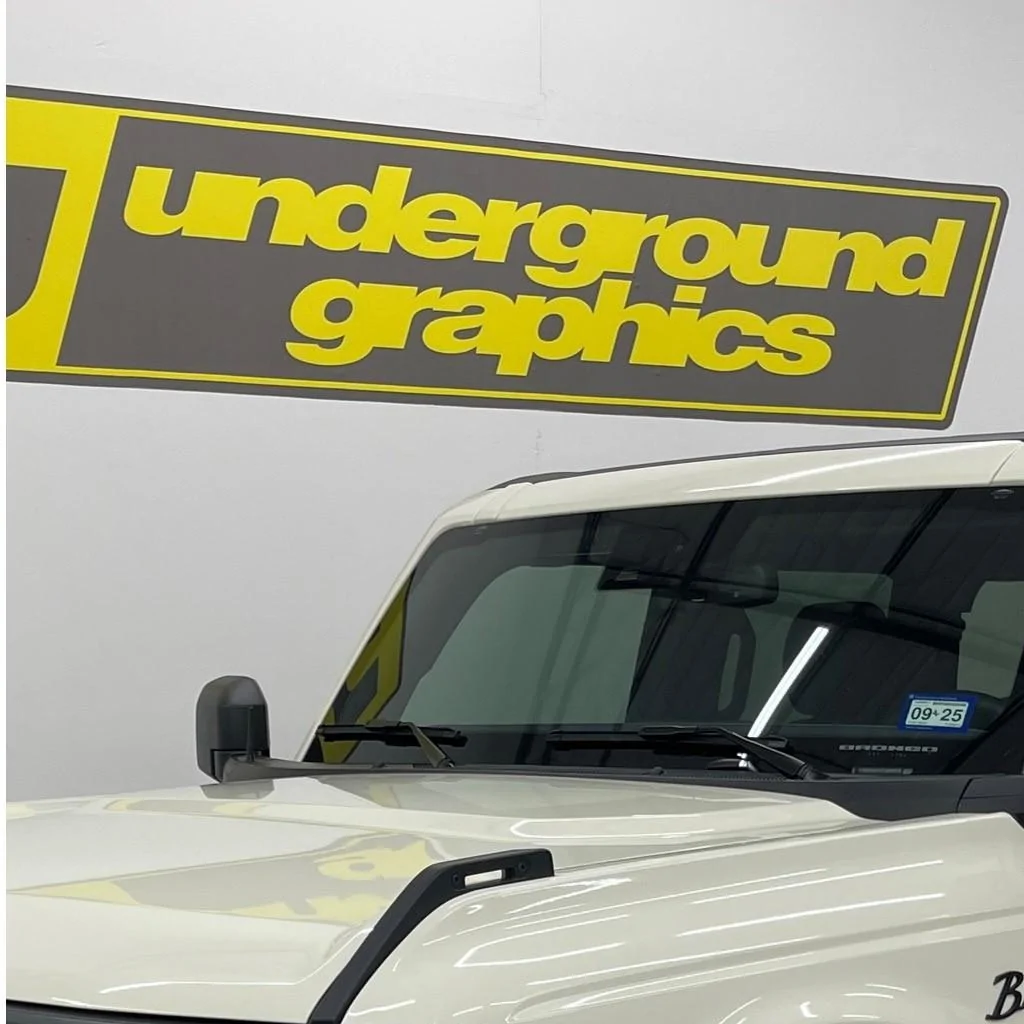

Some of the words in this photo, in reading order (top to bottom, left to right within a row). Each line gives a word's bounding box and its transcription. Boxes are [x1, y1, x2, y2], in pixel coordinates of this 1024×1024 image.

[123, 165, 966, 298] underground
[285, 277, 837, 377] graphics
[911, 707, 933, 720] 09
[940, 708, 964, 722] 25
[985, 970, 1024, 1021] B
